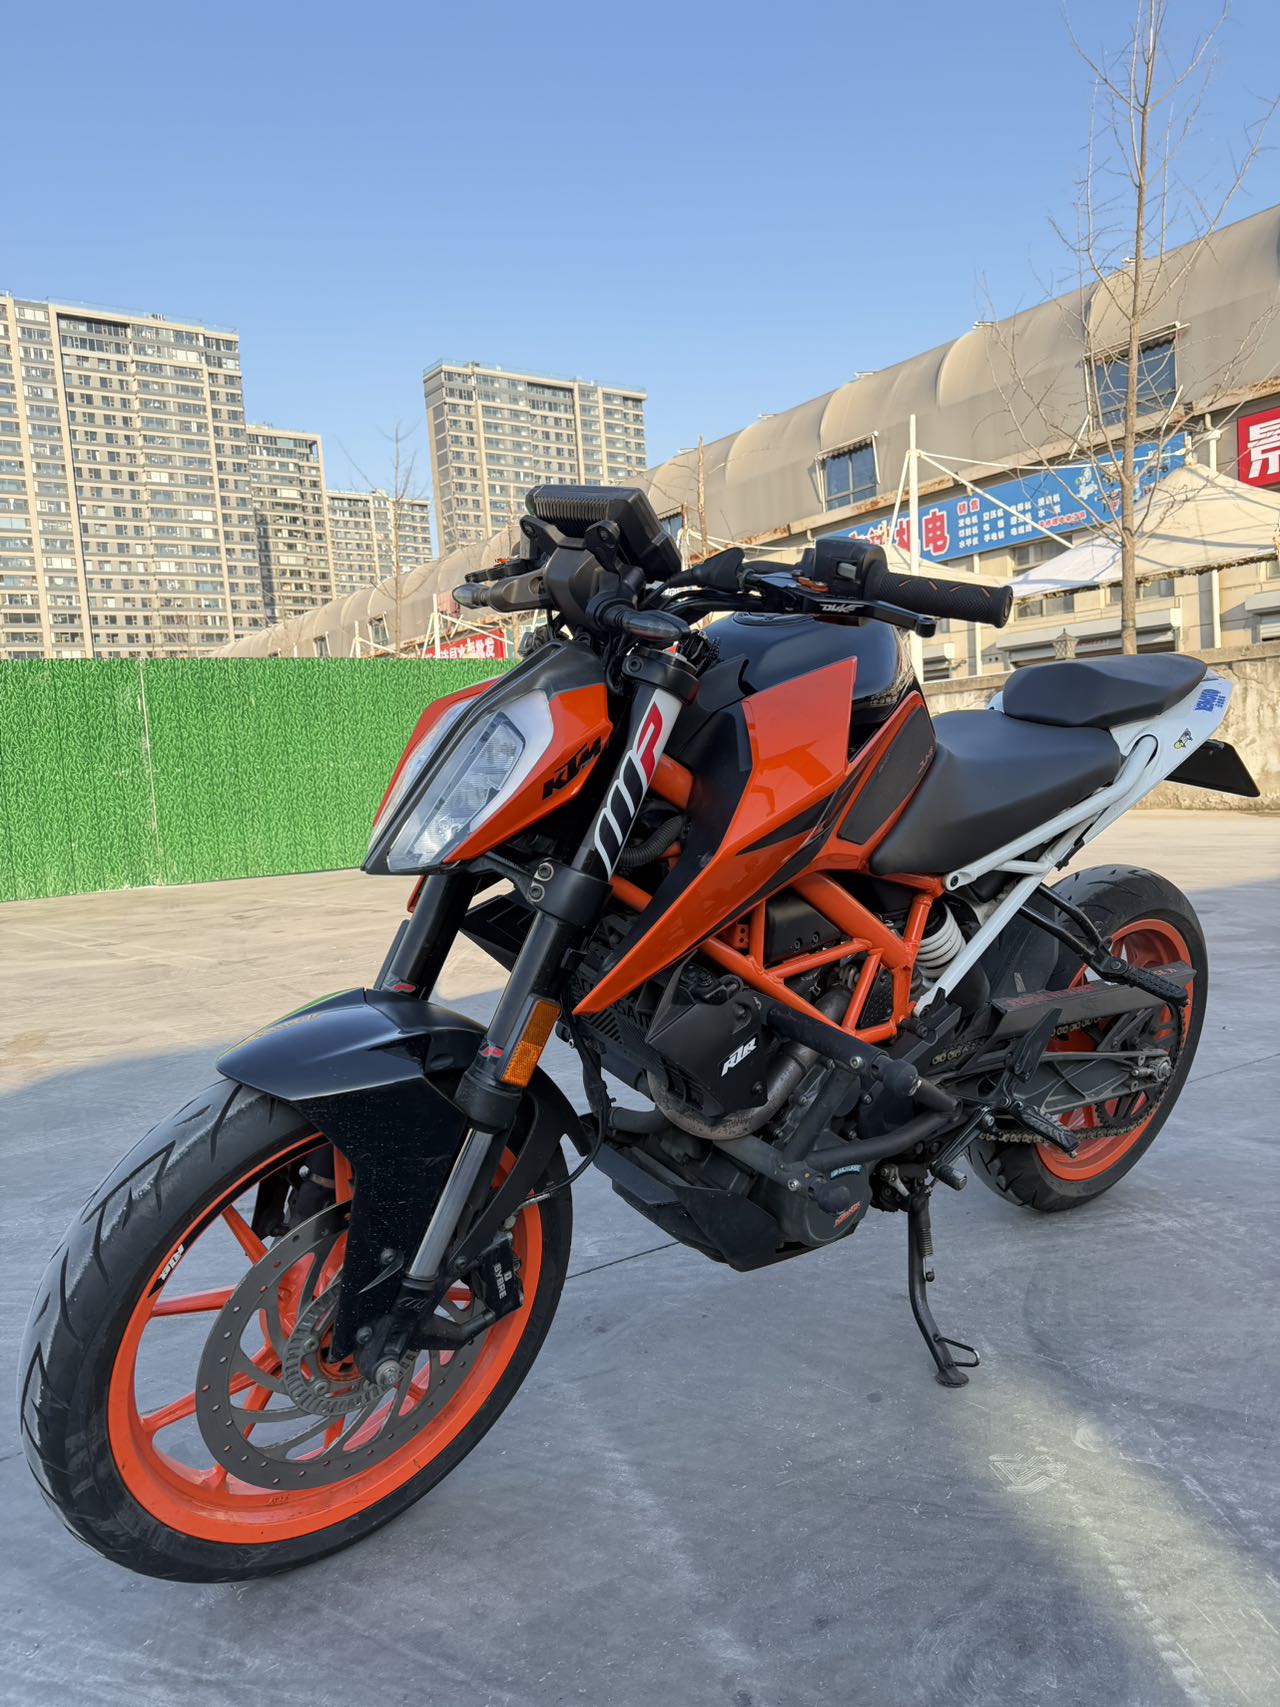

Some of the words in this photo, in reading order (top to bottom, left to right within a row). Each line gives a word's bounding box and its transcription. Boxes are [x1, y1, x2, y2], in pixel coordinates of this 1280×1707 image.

[820, 603, 864, 613] DUKE
[541, 735, 602, 801] KTM
[493, 1262, 508, 1300] BYBRE
